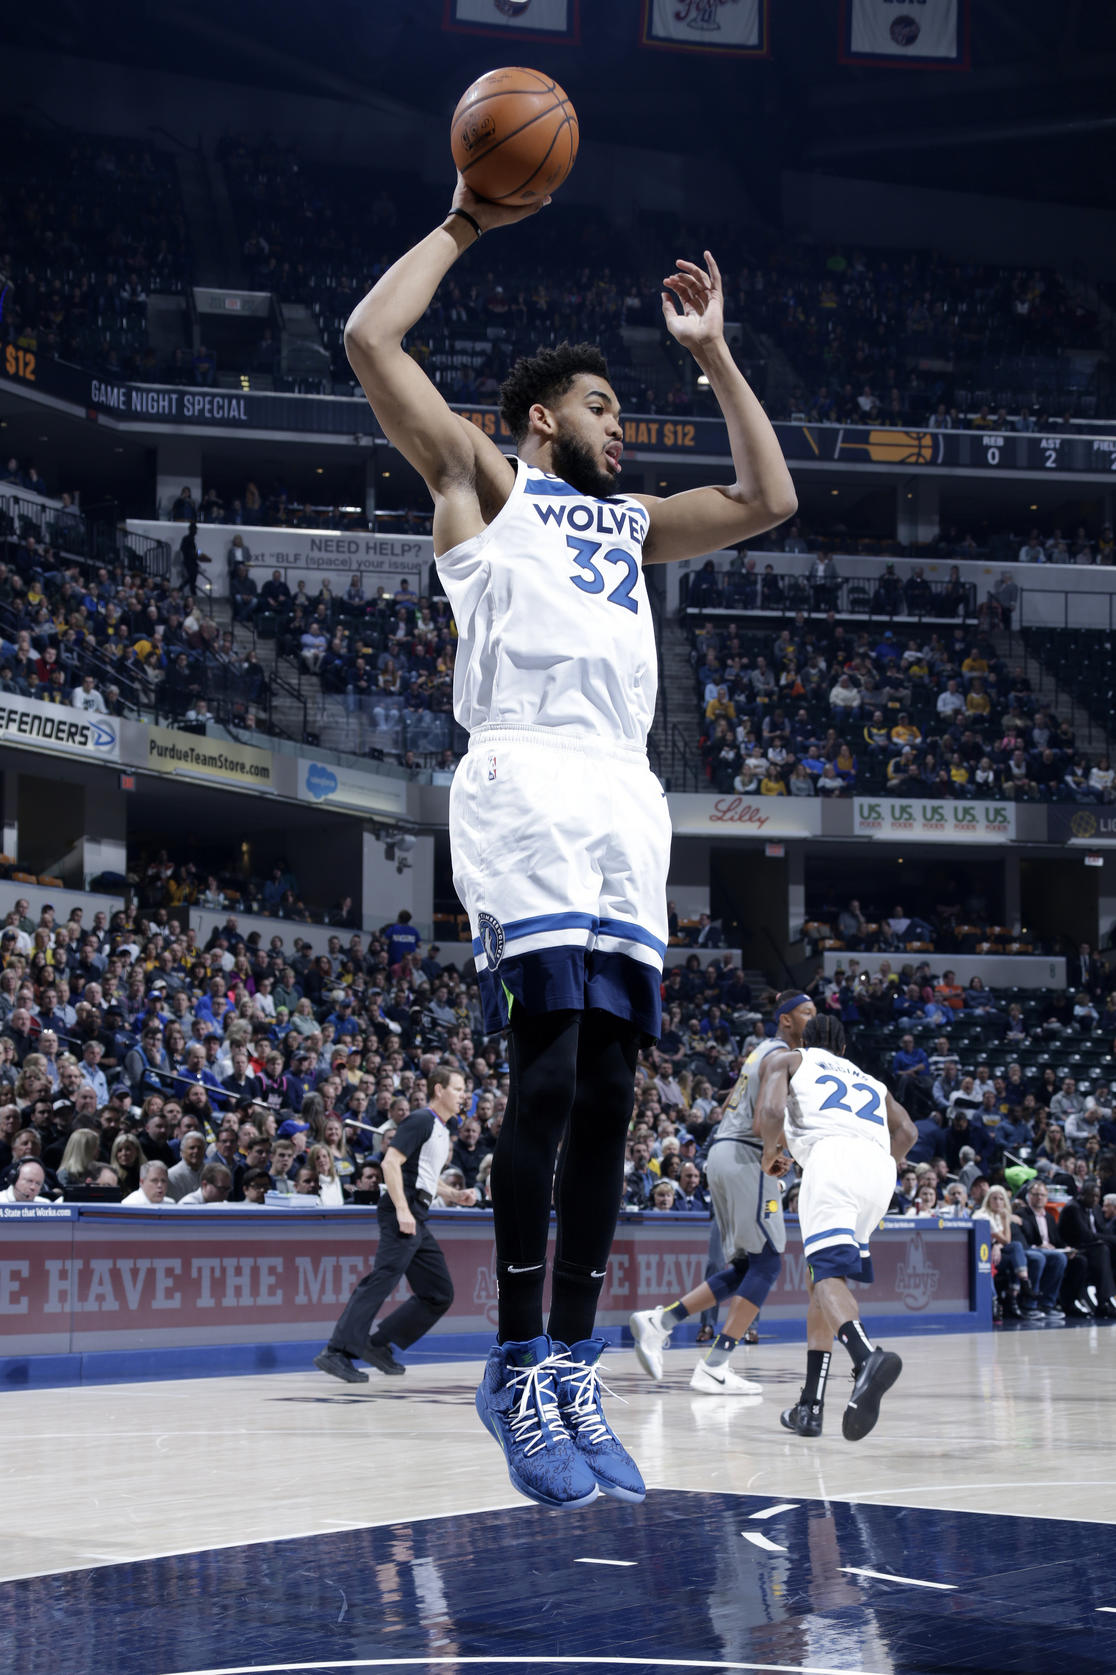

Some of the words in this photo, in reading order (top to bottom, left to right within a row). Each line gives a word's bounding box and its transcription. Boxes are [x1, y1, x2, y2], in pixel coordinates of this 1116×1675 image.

[5, 344, 36, 381] $12
[91, 380, 127, 409] GAME
[131, 390, 179, 415] NIGHT
[183, 394, 248, 420] SPECIAL
[625, 421, 660, 443] HAT
[664, 422, 696, 447] $12
[983, 436, 1004, 446] REB
[1040, 439, 1061, 449] AST
[987, 447, 1000, 465] 0
[1044, 450, 1057, 467] 2
[310, 538, 360, 554] NEED
[365, 541, 422, 557] HELP?
[305, 556, 353, 568] (space)
[357, 560, 384, 572] your
[565, 534, 639, 615] 32
[150, 740, 270, 779] PurdueTeamStore.com
[709, 797, 770, 829] Lilly
[815, 1074, 885, 1126] 22
[4, 1208, 21, 1217] State
[21, 1207, 35, 1217] that
[36, 1207, 71, 1217] Works.com
[44, 1258, 182, 1314] HAVE
[191, 1257, 283, 1308] THE
